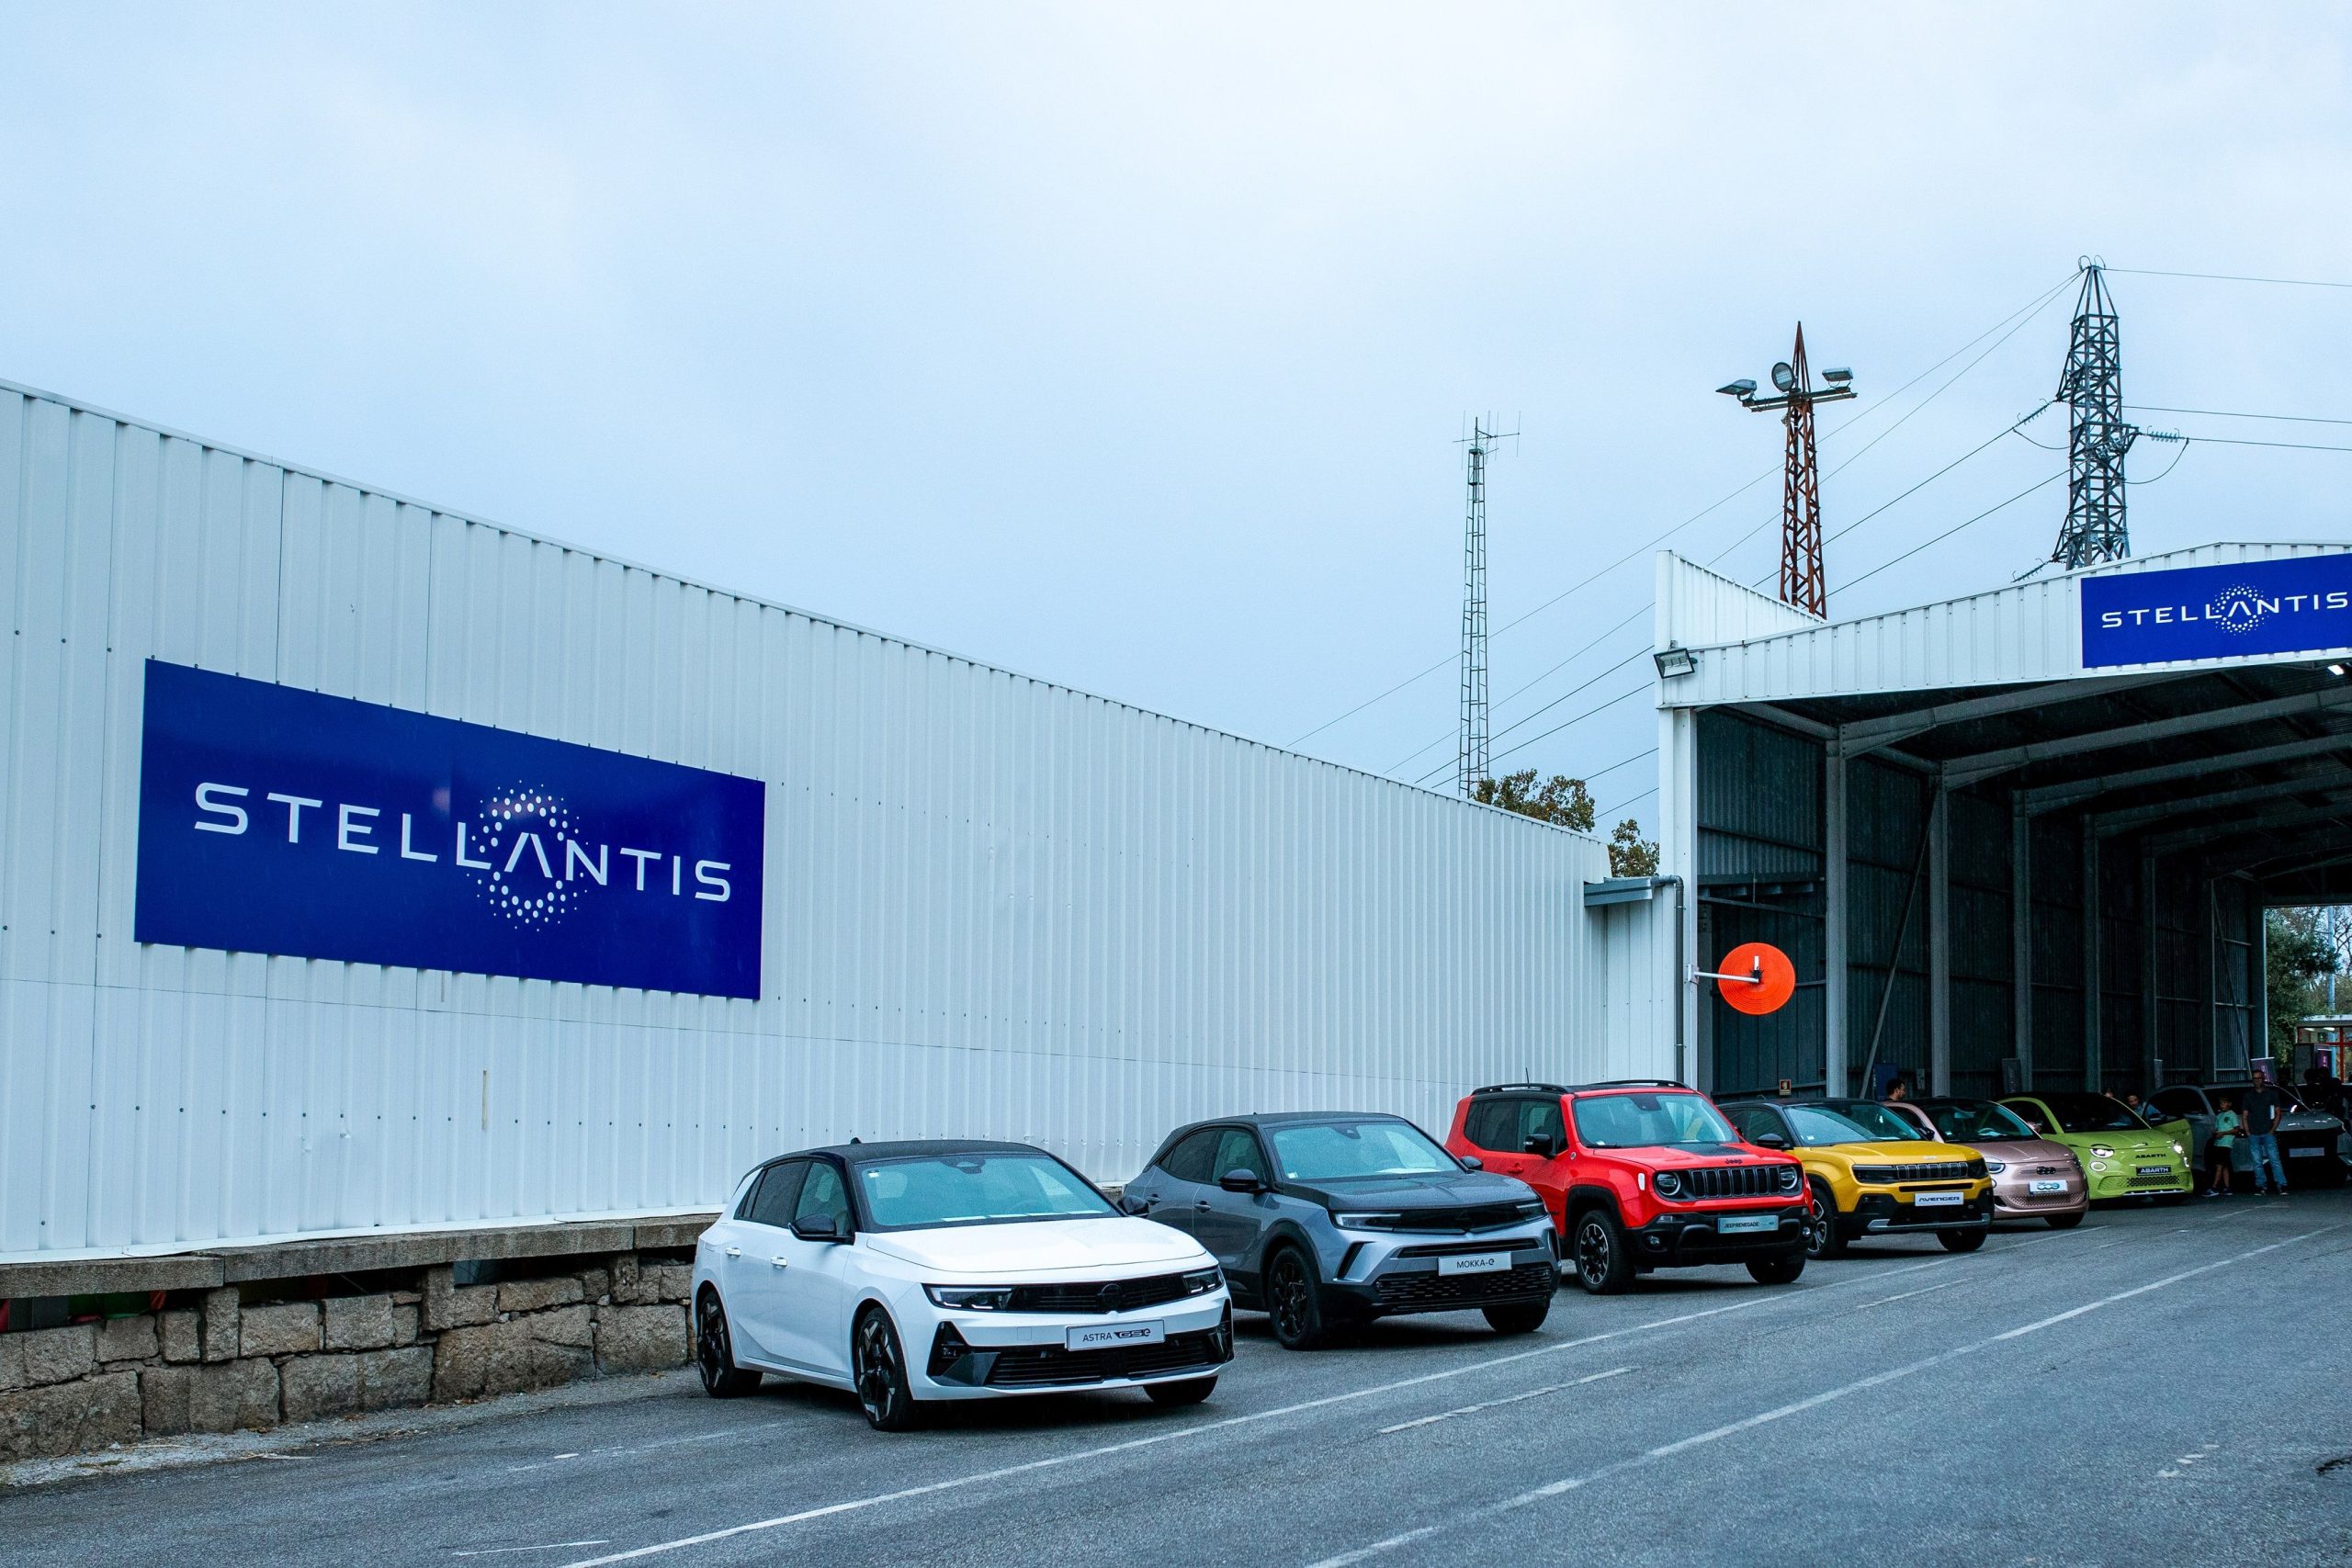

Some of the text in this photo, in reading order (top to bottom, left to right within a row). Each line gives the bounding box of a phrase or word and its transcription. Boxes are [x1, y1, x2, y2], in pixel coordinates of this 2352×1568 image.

[2101, 592, 2348, 628] STELLANTIS
[194, 782, 732, 903] STELLANTIS
[1082, 1332, 1113, 1342] ASTRA
